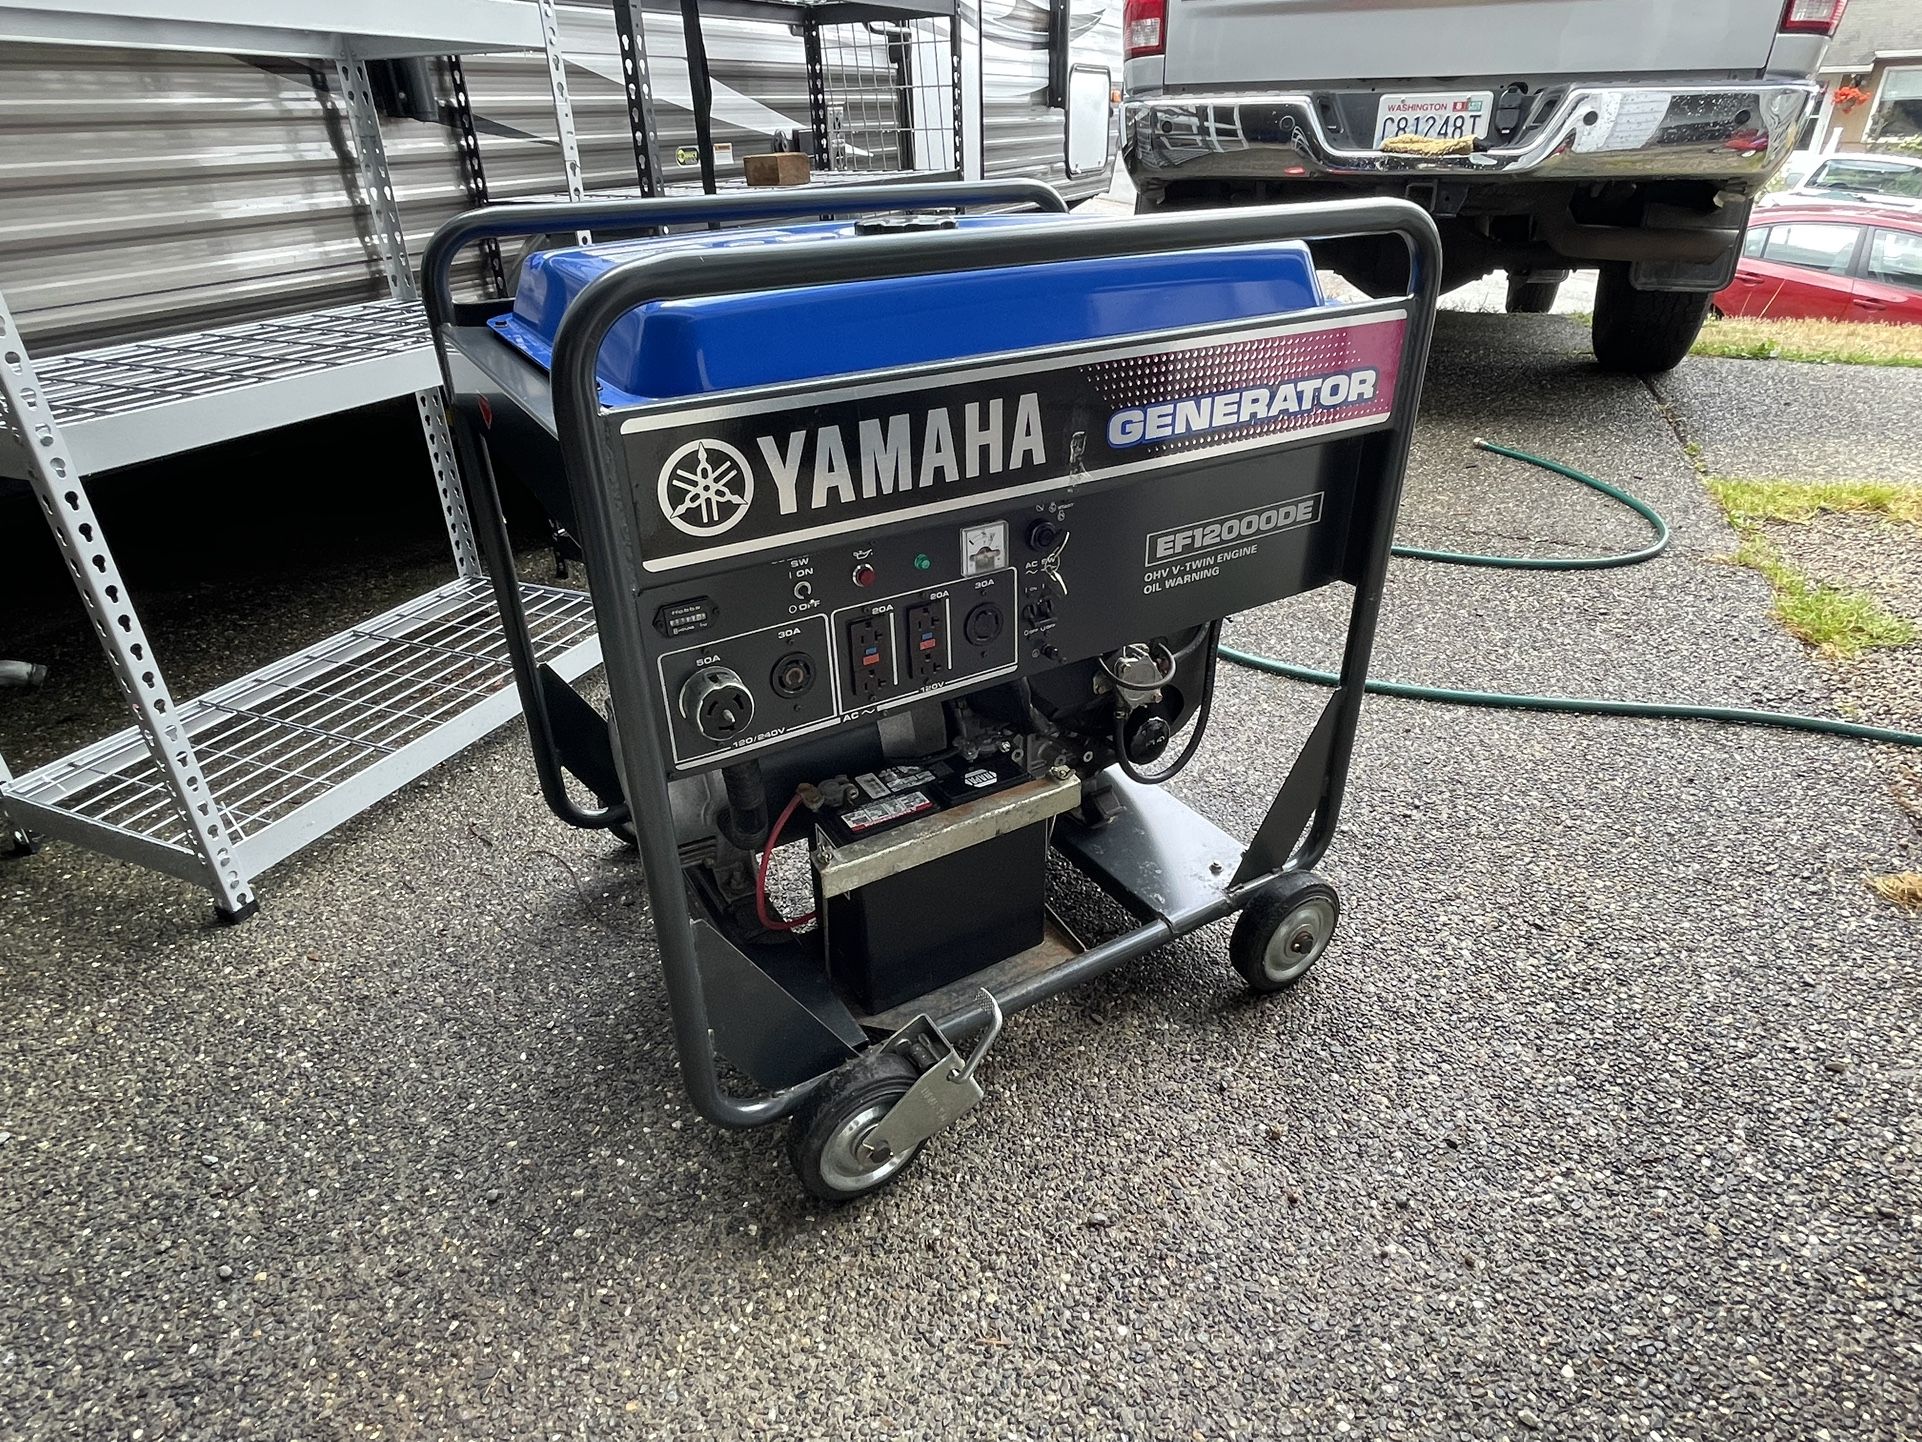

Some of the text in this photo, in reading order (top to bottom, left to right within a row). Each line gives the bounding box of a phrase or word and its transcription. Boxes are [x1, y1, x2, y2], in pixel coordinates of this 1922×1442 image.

[1387, 103, 1447, 112] WASHINGTON
[1381, 114, 1482, 140] C81248T
[1107, 368, 1377, 446] GENERATOR
[756, 392, 1047, 515] YAMAHA
[1156, 500, 1314, 558] EF12000DE
[790, 557, 809, 568] SW
[1025, 560, 1038, 570] AC
[1144, 544, 1259, 582] OHV V-TWIN ENGINE
[796, 567, 814, 578] ON
[975, 578, 995, 590] 30A
[1143, 566, 1221, 595] OIL WARNING
[930, 590, 949, 601] 20A
[872, 604, 894, 615] 20A
[778, 627, 801, 639] 30A
[696, 655, 721, 667] 50A
[919, 681, 944, 693] 120V
[842, 711, 859, 723] AC
[732, 727, 786, 748] 120/240V
